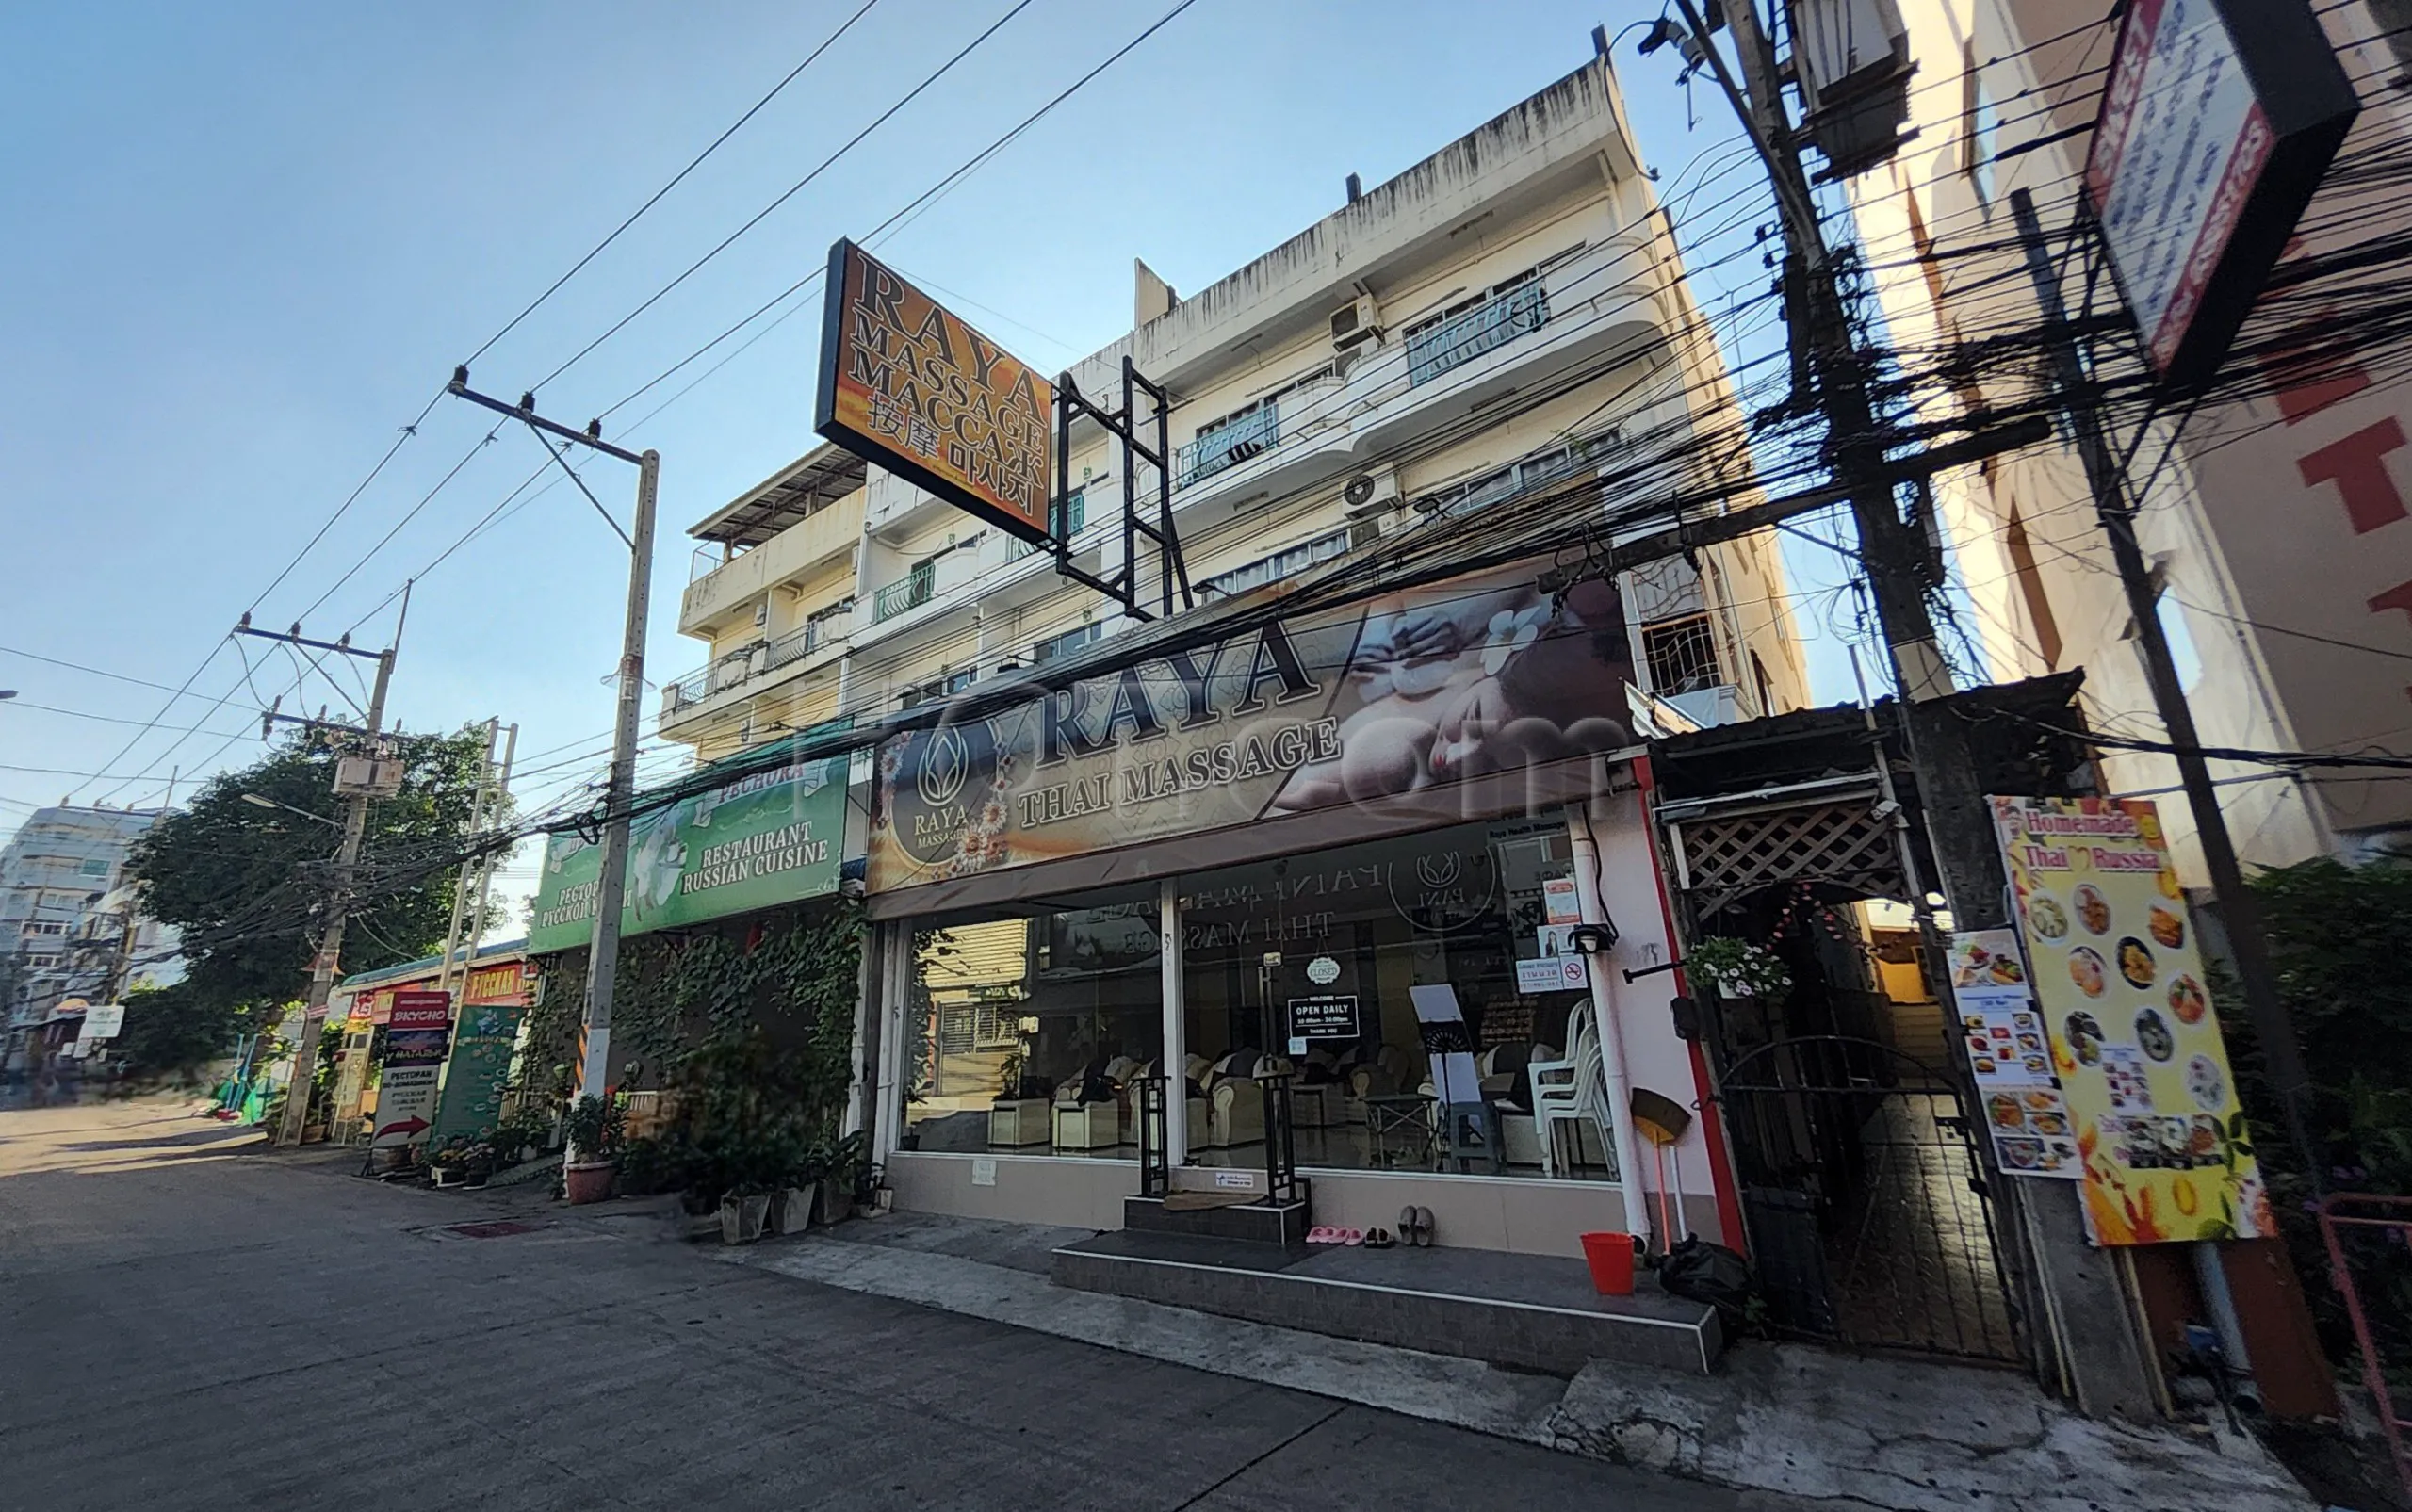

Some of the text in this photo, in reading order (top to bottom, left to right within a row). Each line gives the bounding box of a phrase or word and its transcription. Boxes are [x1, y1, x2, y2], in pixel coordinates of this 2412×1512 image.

[857, 252, 1047, 428] RAYA
[851, 308, 1042, 450] MASSAGE
[849, 343, 1044, 489] МАССАЖ
[868, 395, 940, 459] 按摩
[948, 440, 1033, 516] 마사지
[1036, 617, 1320, 770] RAYA
[1018, 717, 1343, 828] THAI MASSAGE
[914, 805, 969, 836] RAYA
[2026, 808, 2137, 835] Homemade
[702, 821, 812, 868] RESTAURANT
[2024, 845, 2160, 870] Thai Russia
[681, 840, 828, 895] RUSSIAN CUISINE
[559, 880, 600, 906] РЕСТОР
[541, 902, 590, 928] РУССКОЙ
[471, 968, 516, 1000] РУССКАЯ
[1310, 967, 1337, 976] CLOSED
[1296, 1004, 1349, 1016] OPEN DAILY
[391, 1069, 432, 1080] РЕСТОРАН
